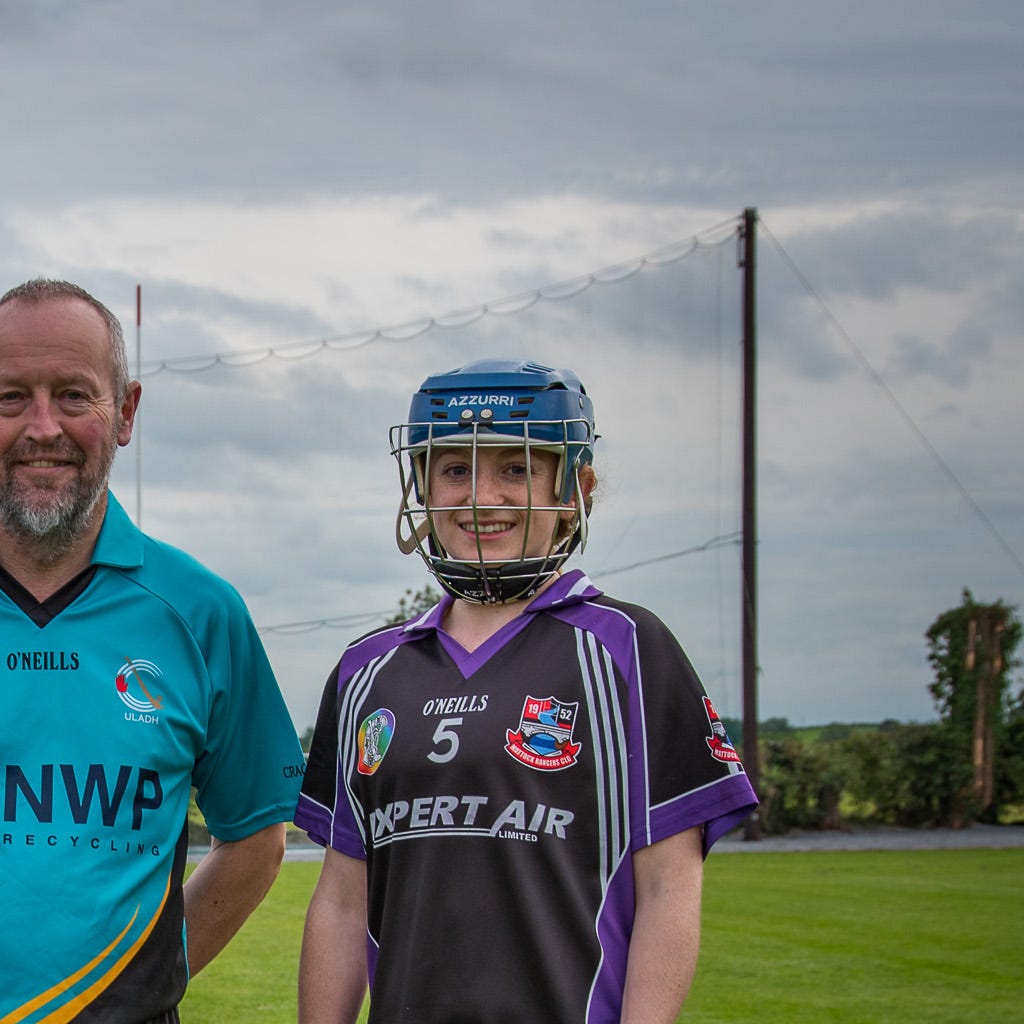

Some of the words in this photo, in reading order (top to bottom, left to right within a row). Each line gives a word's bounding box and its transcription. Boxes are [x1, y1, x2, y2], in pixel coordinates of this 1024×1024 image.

[448, 396, 514, 407] AZZURRI
[7, 651, 80, 670] O'NEILLS
[423, 694, 489, 716] O'NEILLS
[528, 703, 539, 714] 19
[559, 708, 573, 721] 52
[124, 712, 159, 725] ULADH
[427, 717, 463, 763] 5
[3, 764, 164, 831] NWP
[490, 799, 575, 840] AIR
[3, 833, 160, 856] RECYCLING
[498, 830, 538, 842] LIMITED
